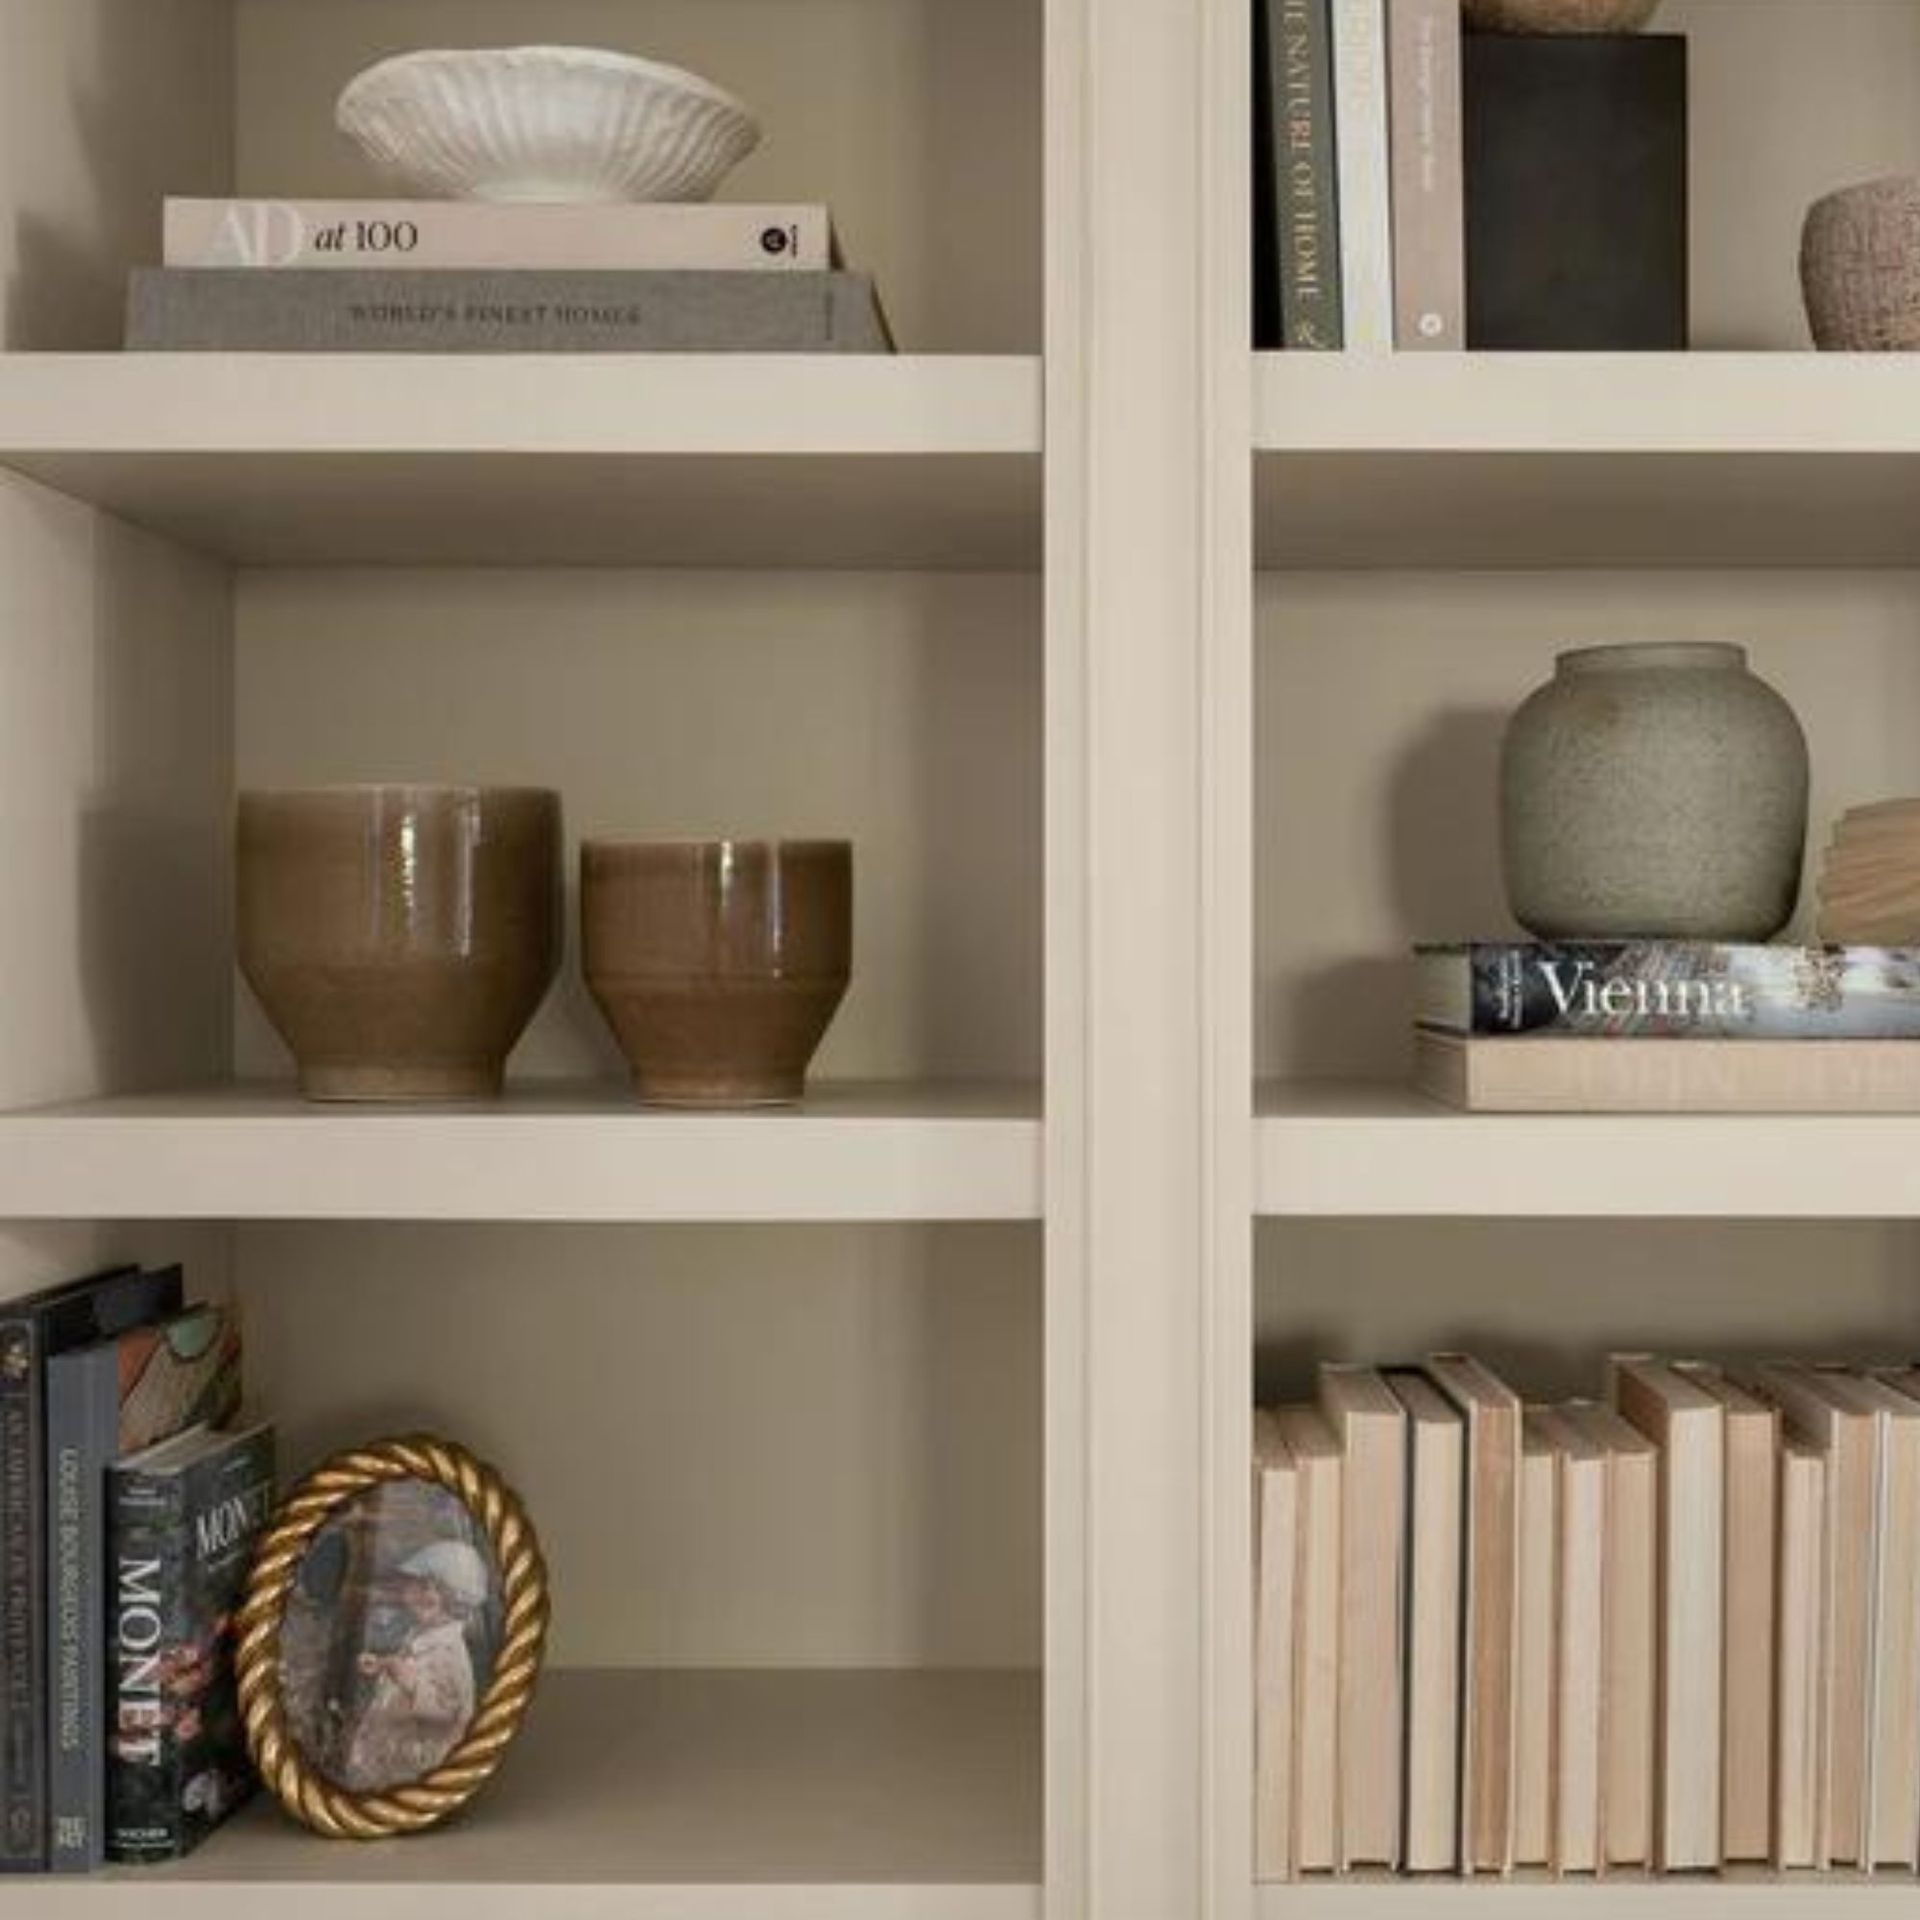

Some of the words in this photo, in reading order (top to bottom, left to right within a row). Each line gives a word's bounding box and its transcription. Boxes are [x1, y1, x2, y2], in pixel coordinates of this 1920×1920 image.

[1283, 34, 1312, 152] NATURE
[1293, 160, 1316, 198] OF
[205, 202, 302, 268] AD
[315, 220, 347, 251] at
[355, 219, 419, 251] 100
[1293, 211, 1320, 304] HOME
[555, 305, 641, 326] HOMES
[1537, 960, 1748, 1017] Vienna
[58, 1448, 79, 1521] LOUISE
[58, 1526, 80, 1639] BOURGEOIS
[59, 1645, 80, 1751] PAINTINGS
[118, 1557, 162, 1767] MONET
